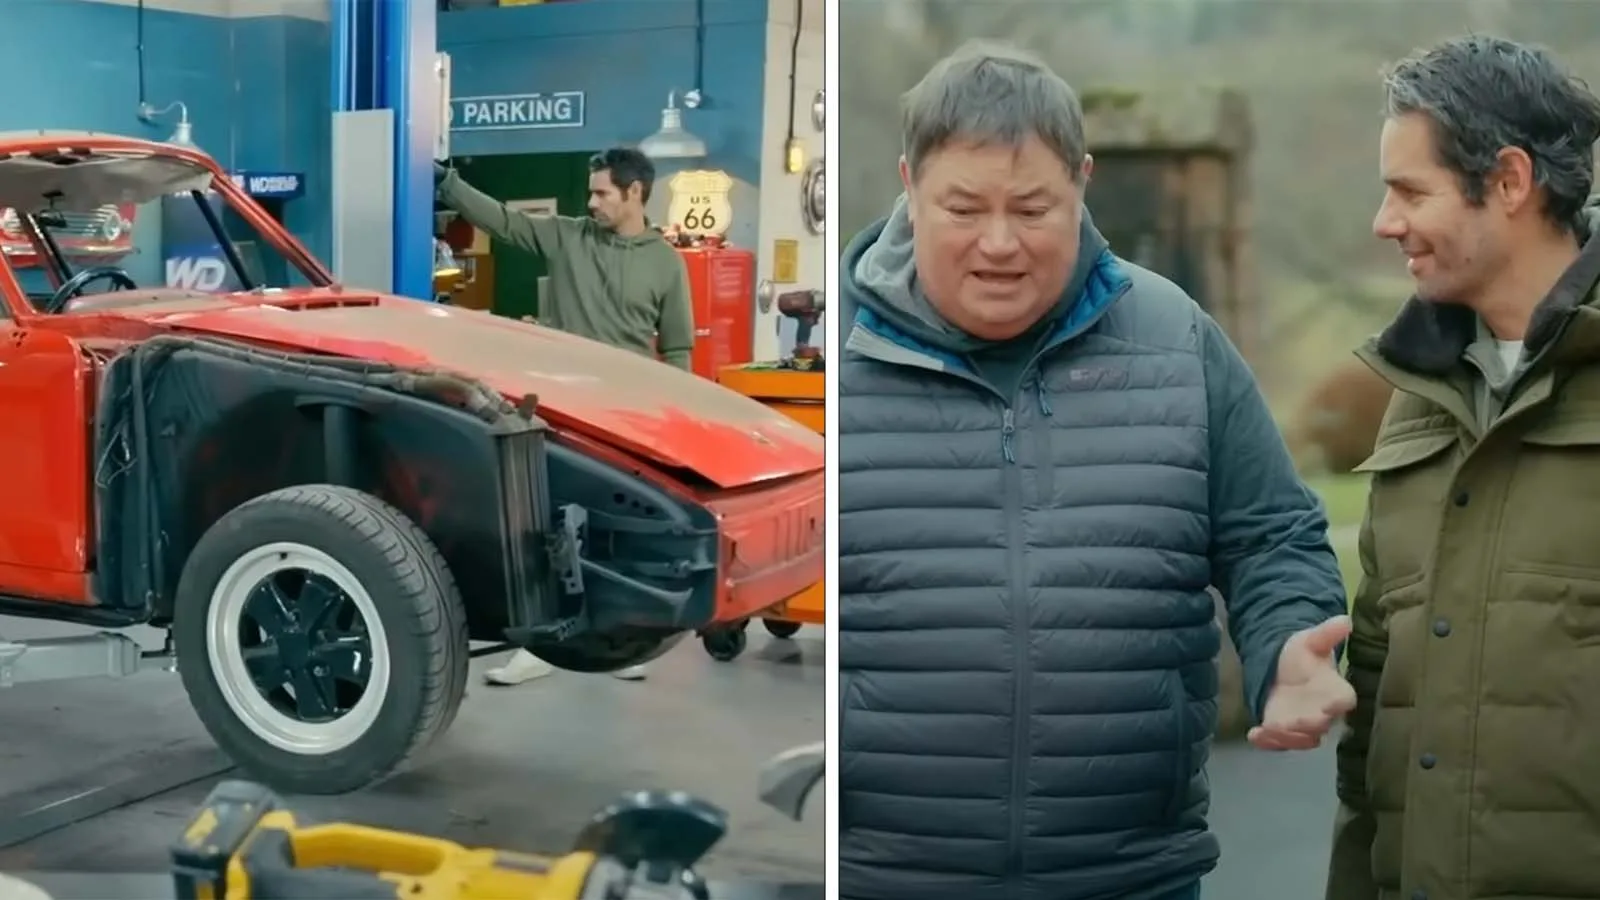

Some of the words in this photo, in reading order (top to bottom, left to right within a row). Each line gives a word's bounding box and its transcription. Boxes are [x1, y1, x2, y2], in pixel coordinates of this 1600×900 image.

[463, 98, 572, 124] PARKING
[690, 196, 711, 204] US
[684, 208, 716, 230] 66
